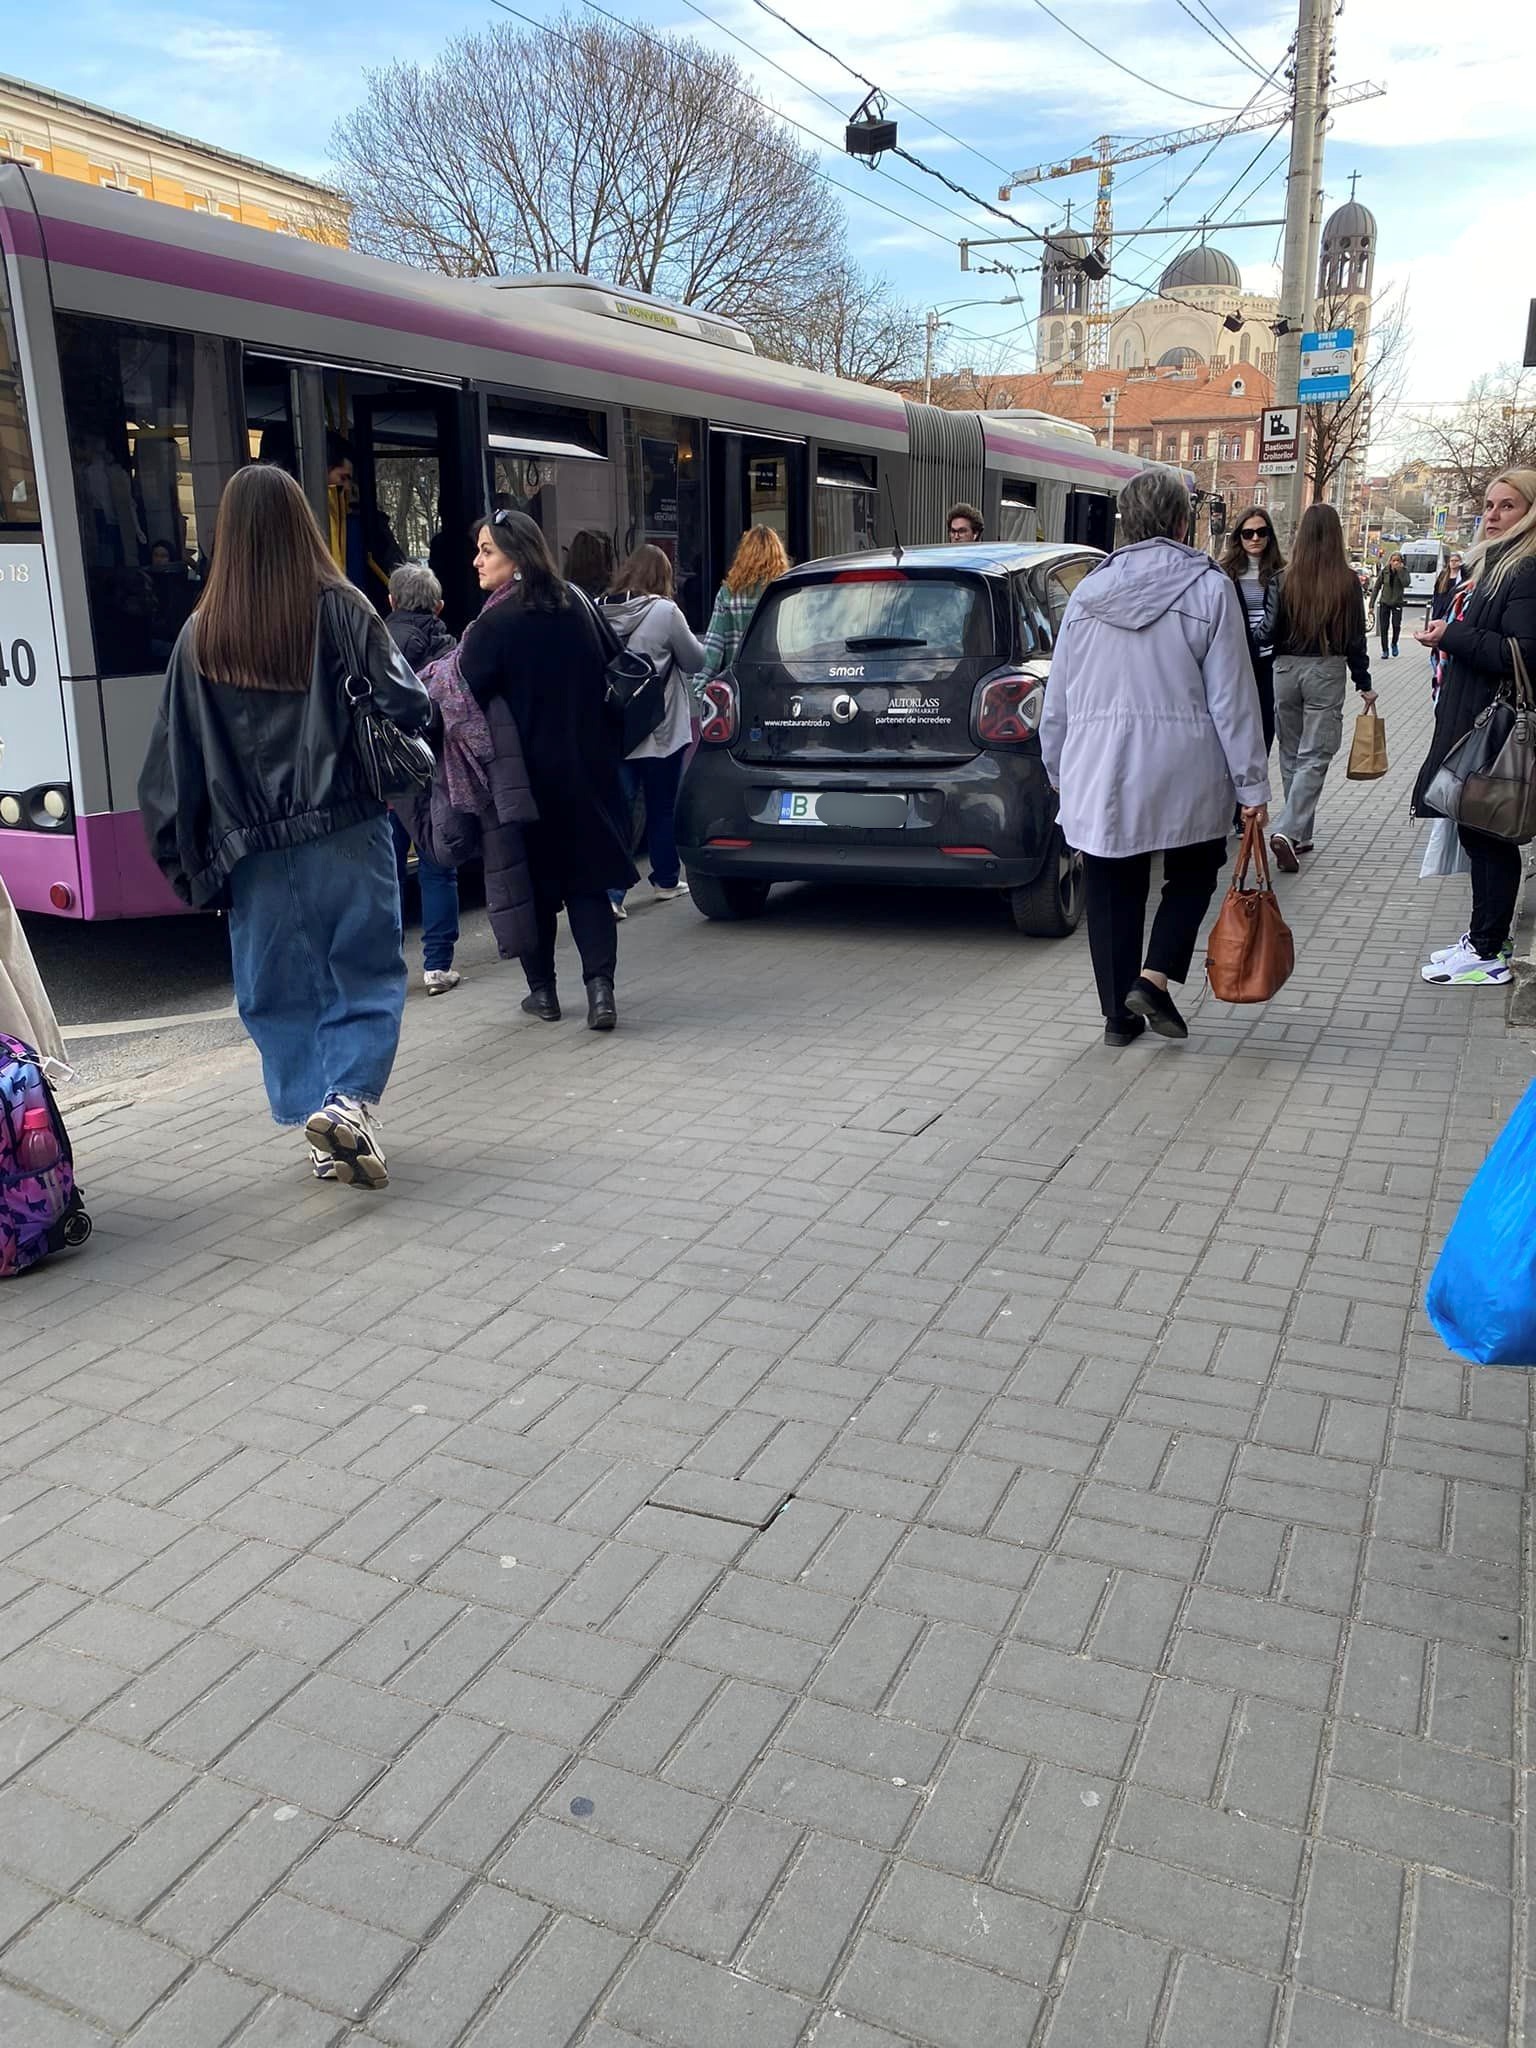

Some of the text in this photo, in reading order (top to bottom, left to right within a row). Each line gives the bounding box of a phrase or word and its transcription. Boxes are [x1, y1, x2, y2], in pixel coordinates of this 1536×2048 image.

[9, 564, 29, 582] 18
[829, 666, 864, 677] smart
[888, 698, 940, 708] AUTOKLASS
[875, 715, 952, 725] partener de incredere
[793, 795, 808, 817] B
